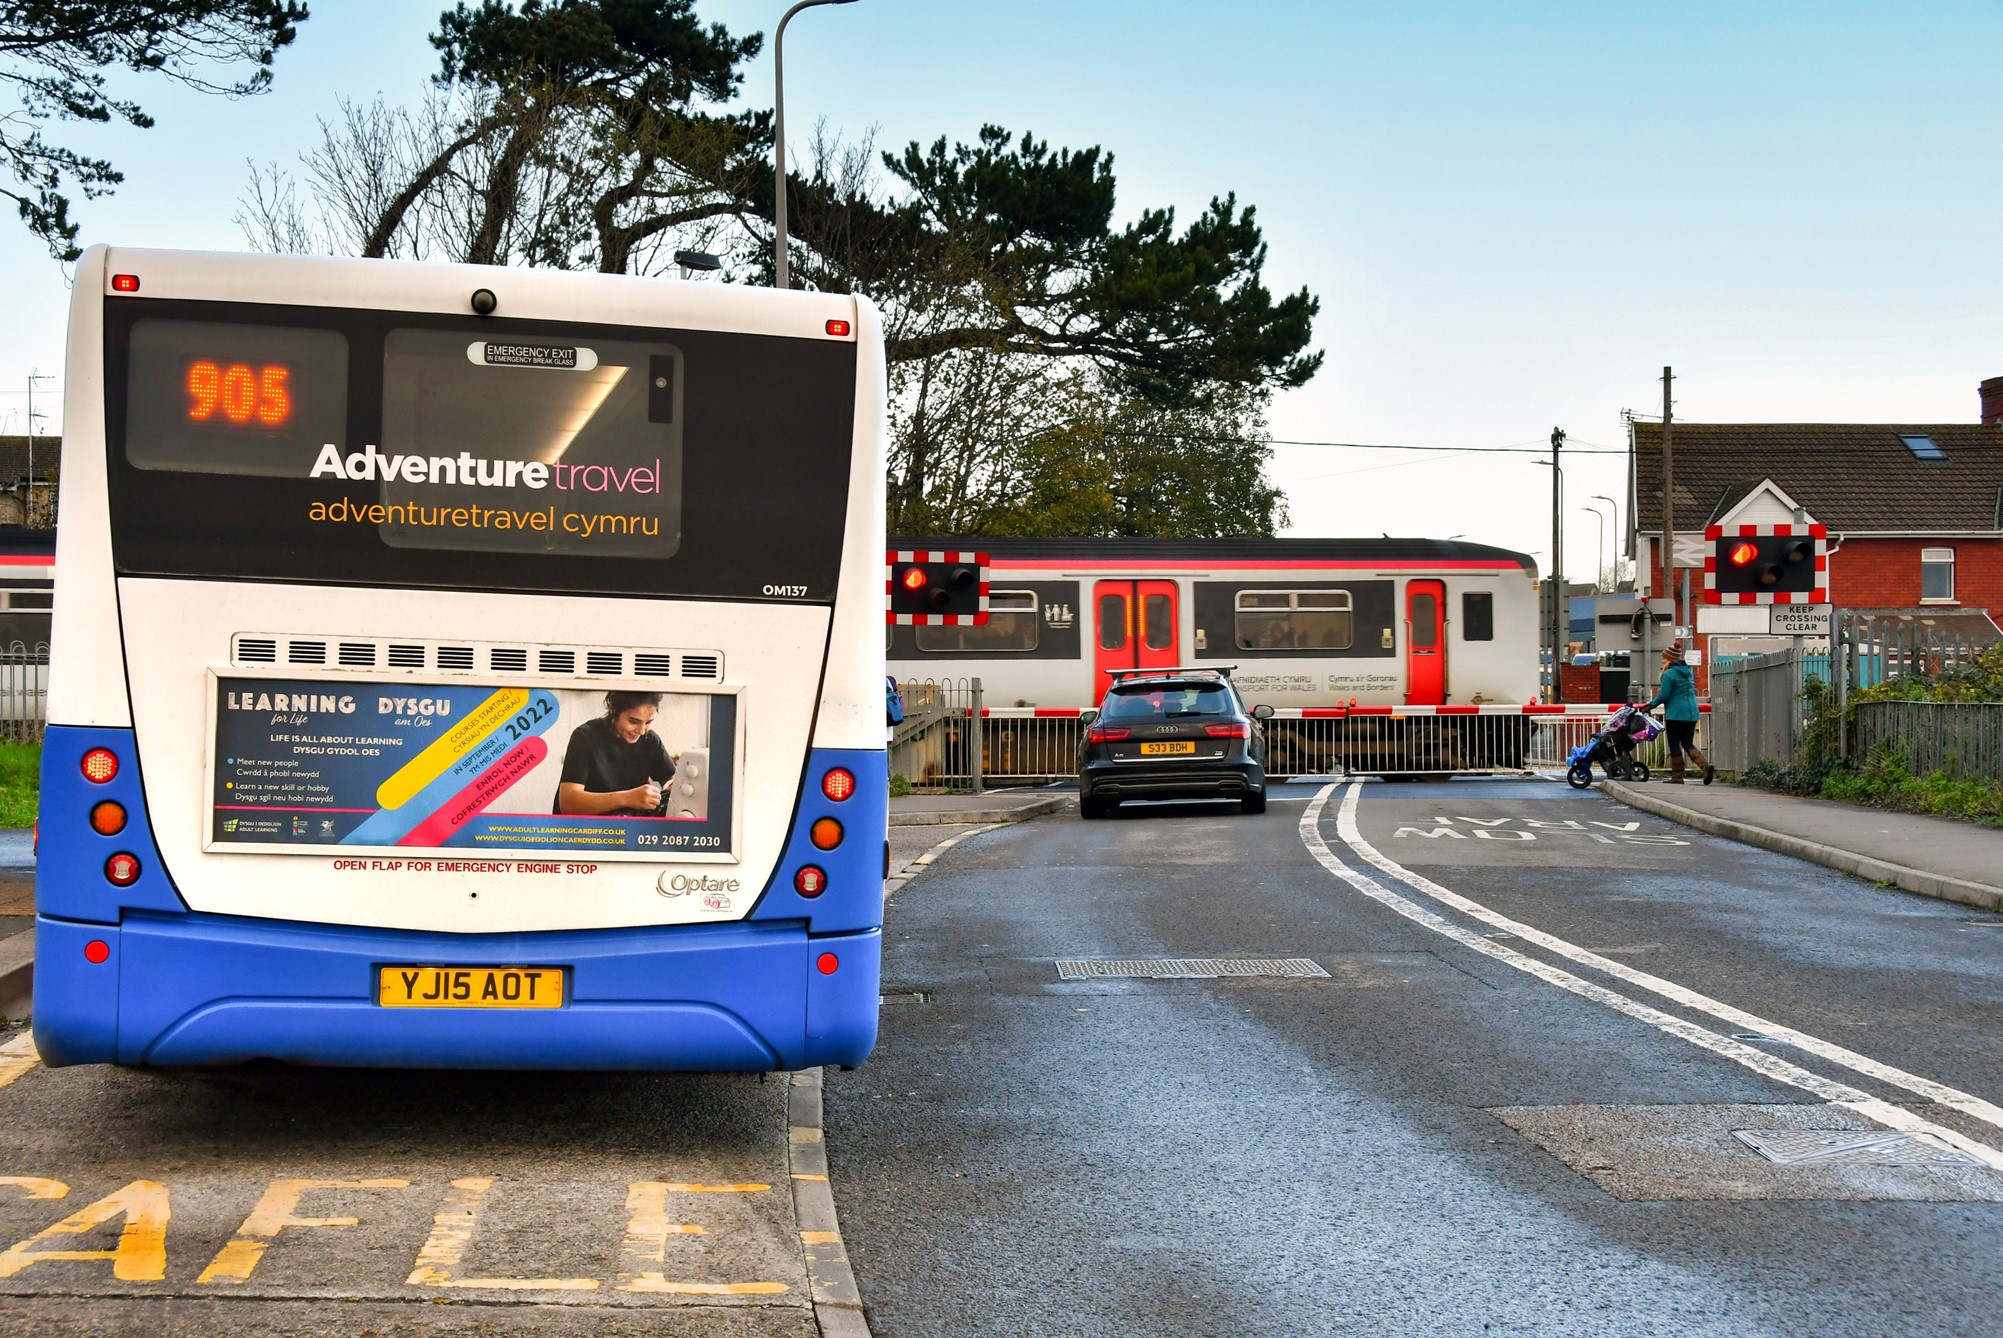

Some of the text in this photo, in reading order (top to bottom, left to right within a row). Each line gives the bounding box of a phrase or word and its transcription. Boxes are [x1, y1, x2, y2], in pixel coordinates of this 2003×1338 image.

[487, 345, 574, 358] EMERGENCY EXIT
[494, 356, 532, 364] EMERGENCY
[554, 358, 574, 366] GLASS
[189, 363, 289, 422] 905
[309, 443, 660, 494] Adventure travel
[308, 497, 659, 538] adventuretravel cymru
[762, 584, 808, 597] OM137
[1789, 606, 1814, 614] KEEP
[1776, 614, 1828, 622] CROSSING
[1282, 676, 1312, 684] CYMRU
[1328, 674, 1354, 684] Cymru
[1271, 684, 1288, 692] FOR
[1290, 684, 1317, 692] WALES
[227, 692, 356, 714] LEARNING
[378, 697, 450, 716] DYSGU
[270, 713, 308, 726] for Life
[394, 716, 432, 727] am Oes
[450, 718, 480, 743] COURSES
[478, 694, 510, 720] STARTING
[505, 698, 553, 741] 2022
[454, 697, 521, 754] CYRSIAU YN DECHRAU
[270, 734, 290, 742] LIFE
[300, 735, 318, 744] ALL
[320, 736, 354, 744] ABOUT
[356, 736, 403, 746] LEARNING
[293, 746, 380, 756] DYSGU GYDOL OES
[1148, 743, 1188, 752] S33 BDH
[236, 758, 256, 766] Meet
[274, 760, 299, 768] people
[454, 766, 464, 776] IN
[463, 740, 496, 769] SEPTEMBER
[468, 742, 508, 775] YM MIS MEDI
[236, 768, 262, 776] Cwrdd
[270, 770, 290, 778] phobl
[292, 770, 320, 780] newydd
[476, 766, 504, 791] ENROL
[504, 748, 524, 768] NOW
[236, 782, 256, 790] Learn
[281, 783, 296, 791] skill
[307, 784, 330, 793] hobby
[450, 754, 536, 826] COFRESTRWCH NAWR
[236, 793, 258, 802] Dysgu
[259, 794, 271, 802] sgil
[288, 794, 304, 802] hobi
[306, 795, 334, 804] newydd
[637, 834, 721, 847] 029 2087 2030
[1393, 827, 1690, 846] SLOW
[333, 860, 598, 874] OPEN FLAP FOR EMERGENCY ENGINE STOP
[671, 874, 740, 896] Optare
[401, 972, 542, 1000] YJ15 AOT
[0, 1176, 788, 1295] AFLE
